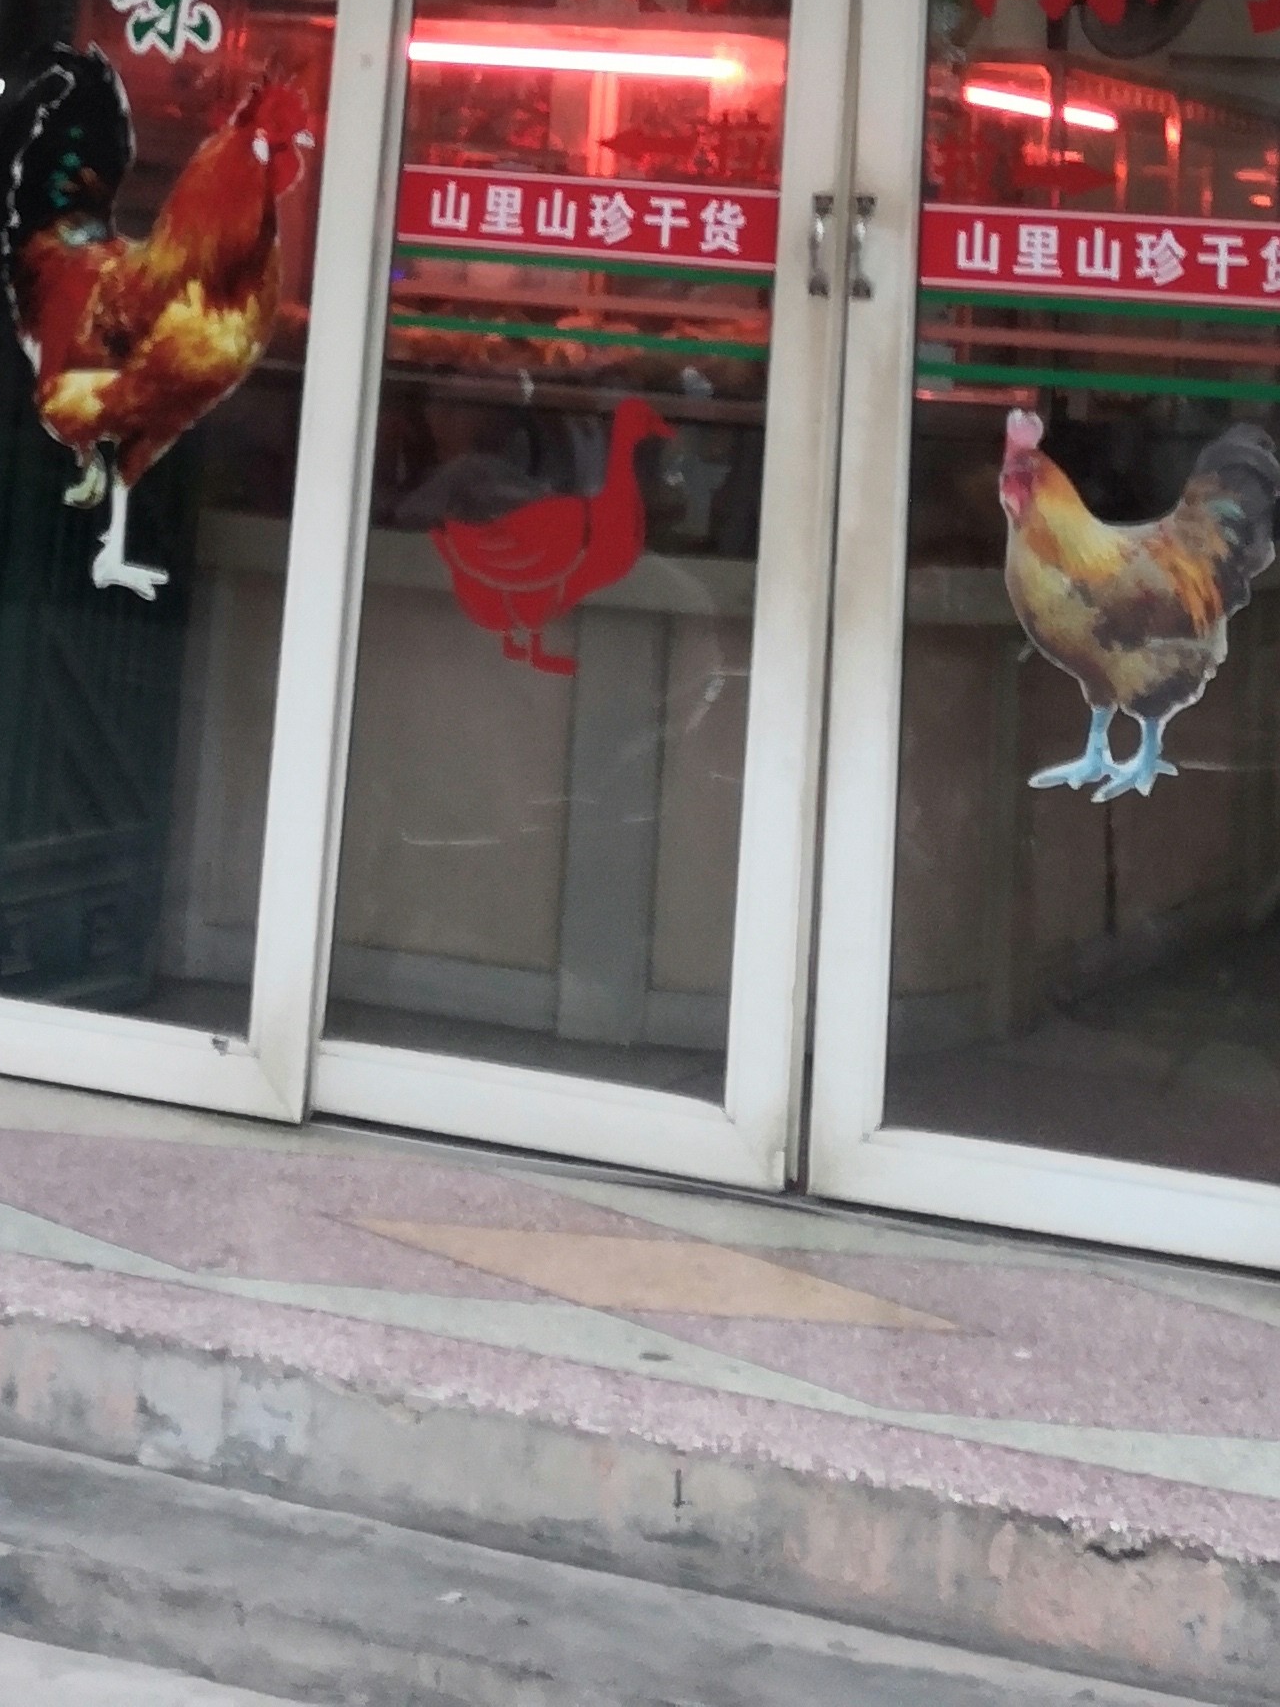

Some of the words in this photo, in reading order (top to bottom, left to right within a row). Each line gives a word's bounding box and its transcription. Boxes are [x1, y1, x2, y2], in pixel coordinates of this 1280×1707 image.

[428, 180, 748, 255] 山里山珍干货
